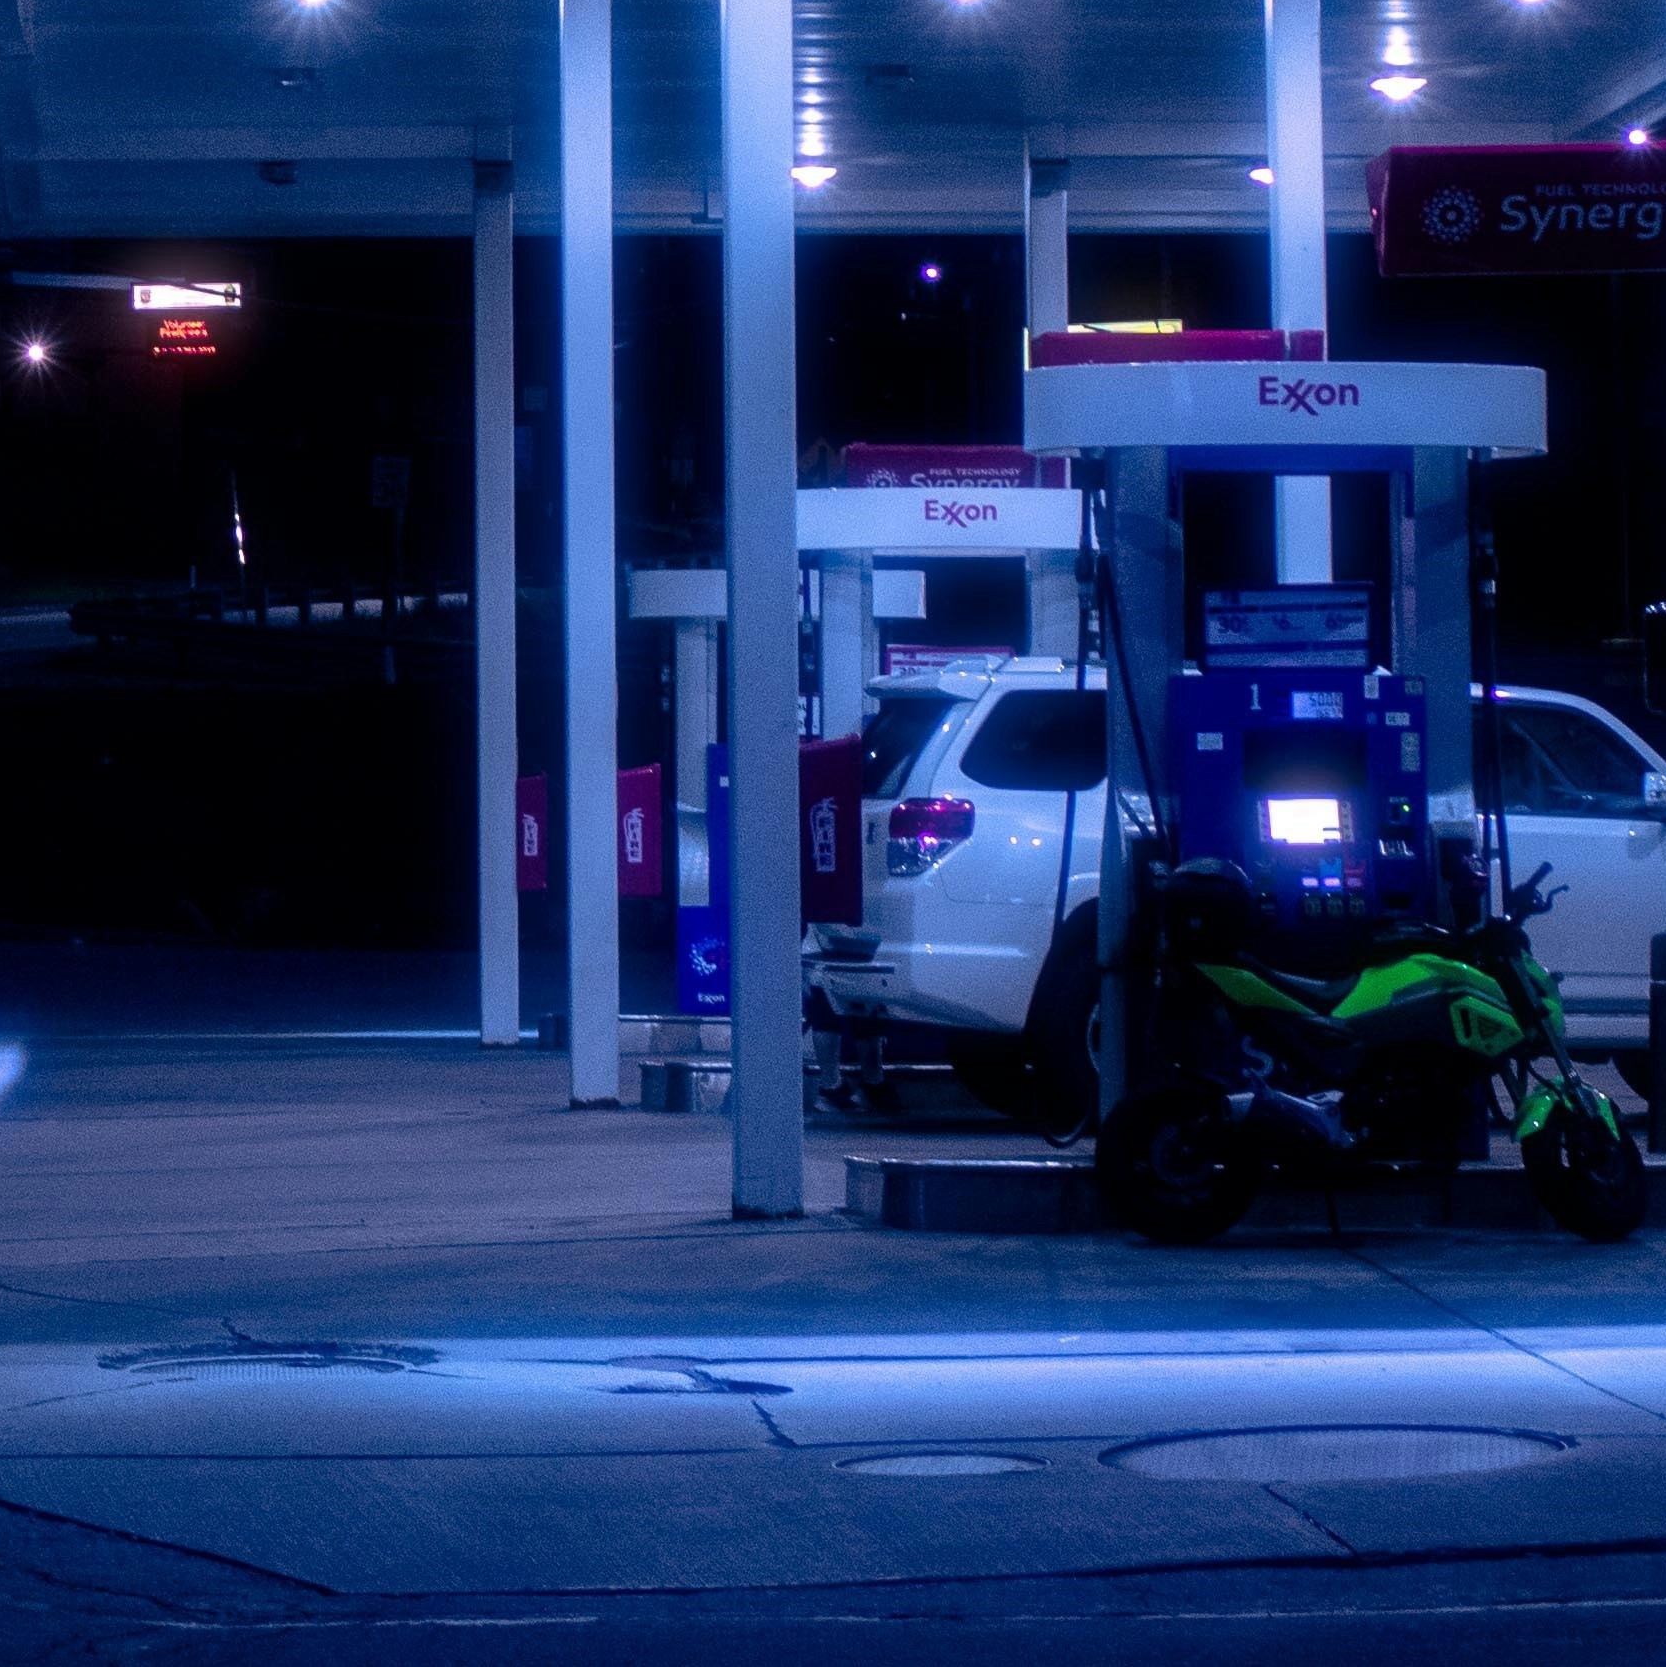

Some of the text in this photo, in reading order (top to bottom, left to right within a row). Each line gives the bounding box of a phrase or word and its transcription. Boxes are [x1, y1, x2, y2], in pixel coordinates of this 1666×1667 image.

[1534, 183, 1576, 198] FUEL
[1259, 376, 1360, 416] Exxon
[955, 467, 1022, 477] TECHNOLOGY
[924, 500, 998, 529] Exxon
[818, 816, 834, 869] FIRE
